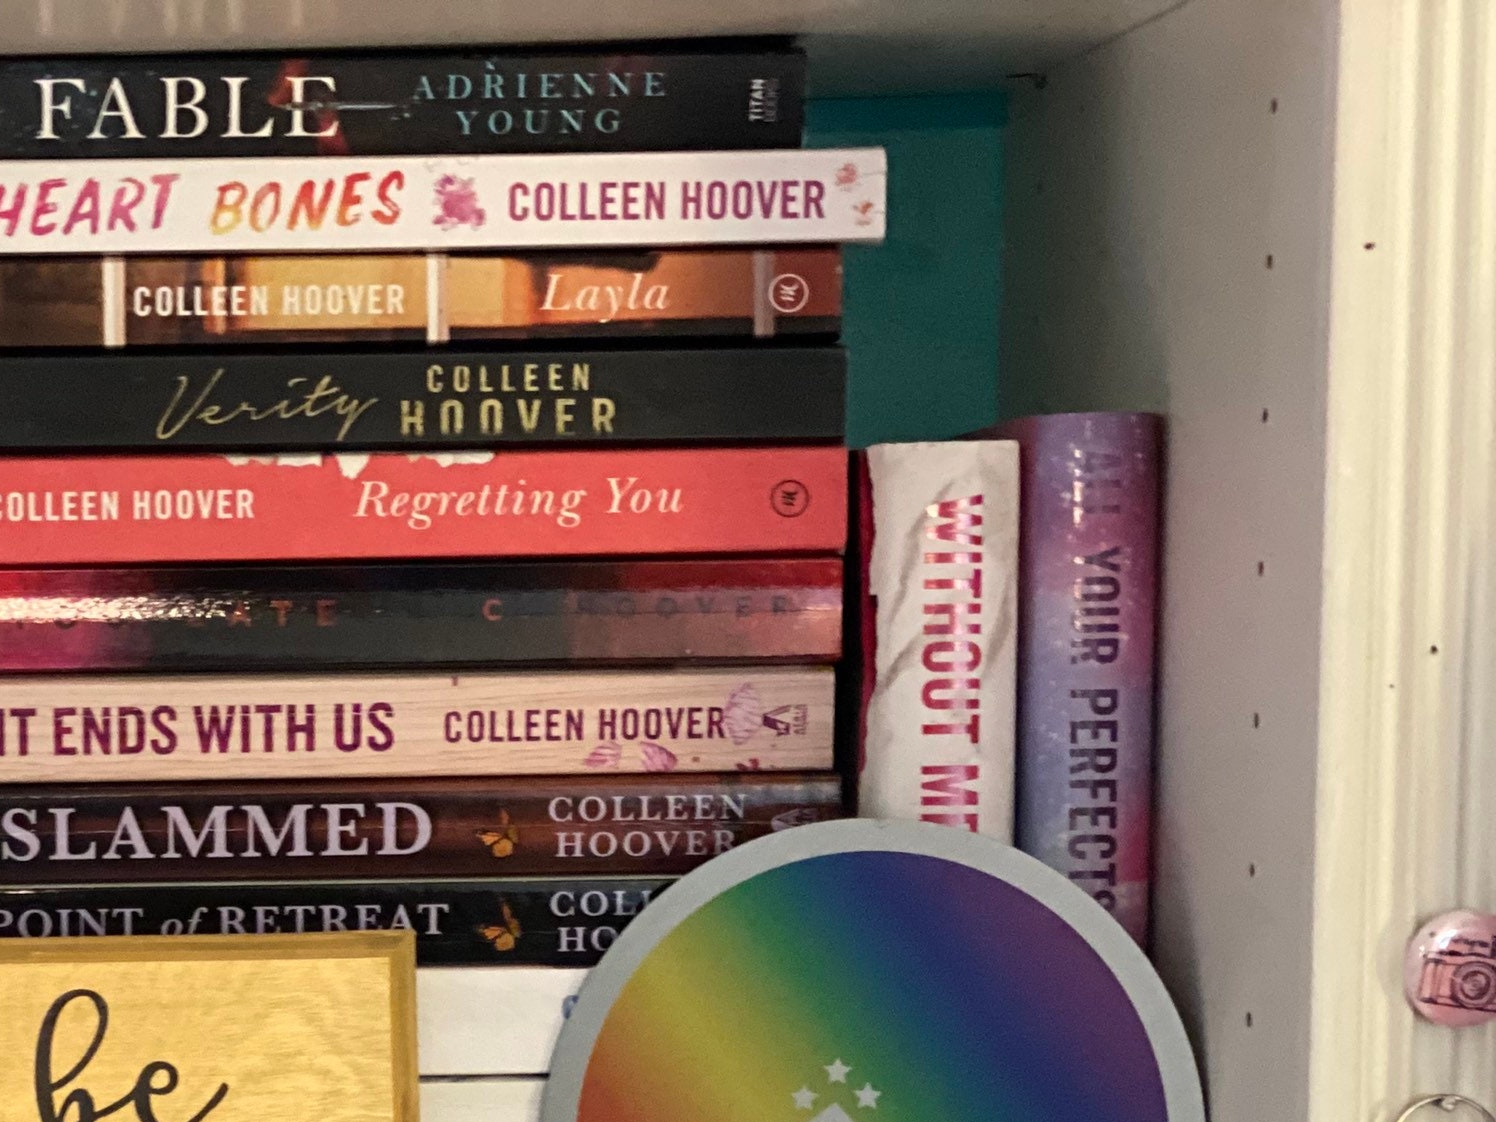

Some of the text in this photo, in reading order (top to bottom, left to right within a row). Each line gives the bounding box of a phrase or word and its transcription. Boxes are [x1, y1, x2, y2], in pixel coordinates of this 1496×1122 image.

[412, 71, 668, 102] ADRIENNE
[34, 75, 342, 141] FABLE
[455, 108, 623, 135] YOUNG
[208, 169, 406, 236] BONES
[507, 179, 826, 222] COLLEEN HOOVER
[132, 283, 406, 318] COLLEEN HOOVER
[539, 273, 672, 323] Layla
[426, 362, 592, 393] COLLEEN
[155, 368, 381, 441] Verity
[400, 397, 618, 437] HOOVER
[132, 489, 256, 521] HOOVER
[353, 477, 685, 530] Regretting You
[920, 493, 984, 744] WITHOUT
[53, 704, 178, 756] ENDS
[195, 702, 316, 754] WITH
[333, 701, 395, 752] US
[444, 706, 727, 743] COLLEEN HOOVER
[548, 793, 748, 823] COLLEEN
[0, 801, 434, 862] SLAMMED
[554, 829, 737, 859] HOOVER
[161, 906, 208, 937] of
[215, 903, 450, 936] RETREAT
